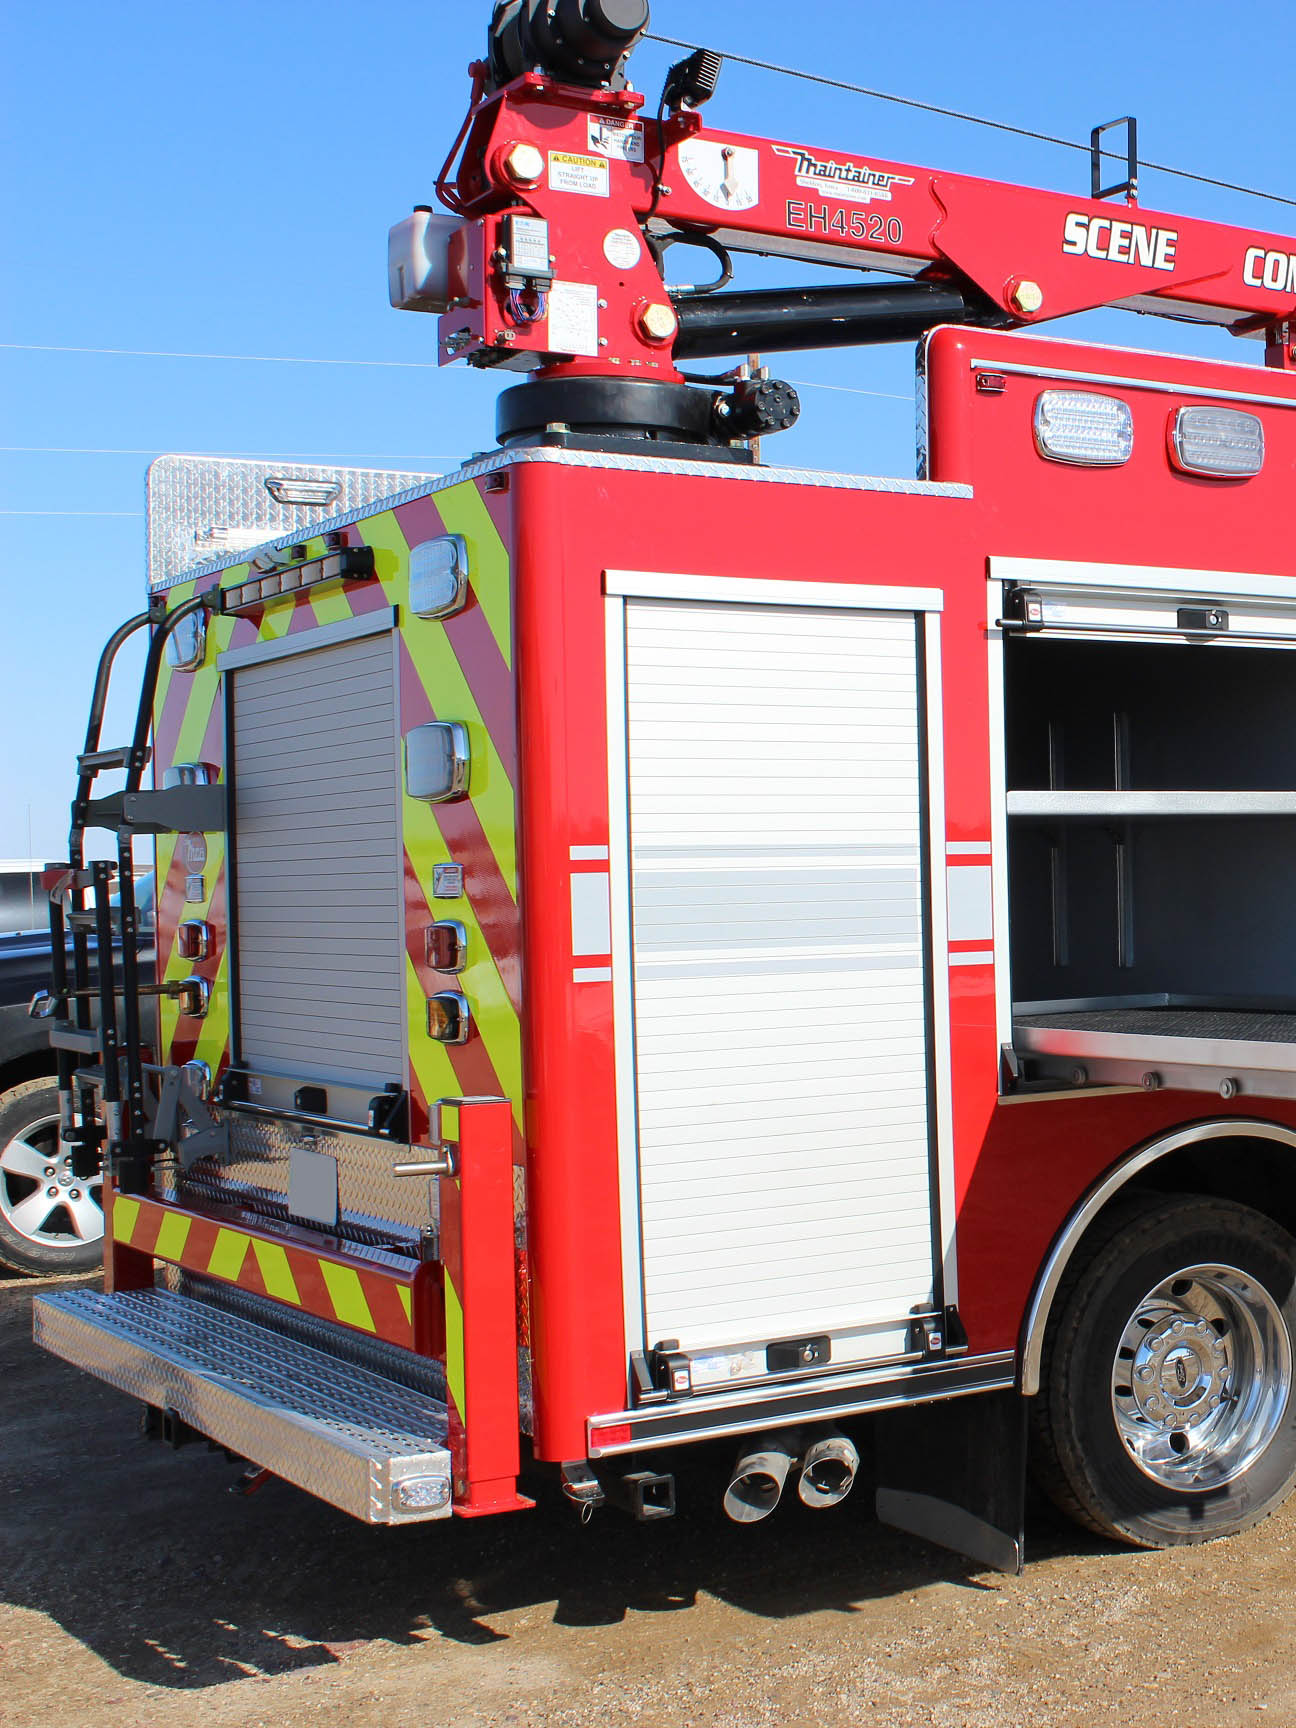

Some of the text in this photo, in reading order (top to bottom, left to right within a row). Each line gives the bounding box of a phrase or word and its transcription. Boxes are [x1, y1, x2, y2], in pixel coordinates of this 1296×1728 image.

[605, 119, 634, 129] DANGER
[561, 154, 597, 166] CAUTION
[788, 149, 897, 188] Maintainer
[786, 199, 903, 245] EH4520
[1062, 211, 1178, 272] SCENE
